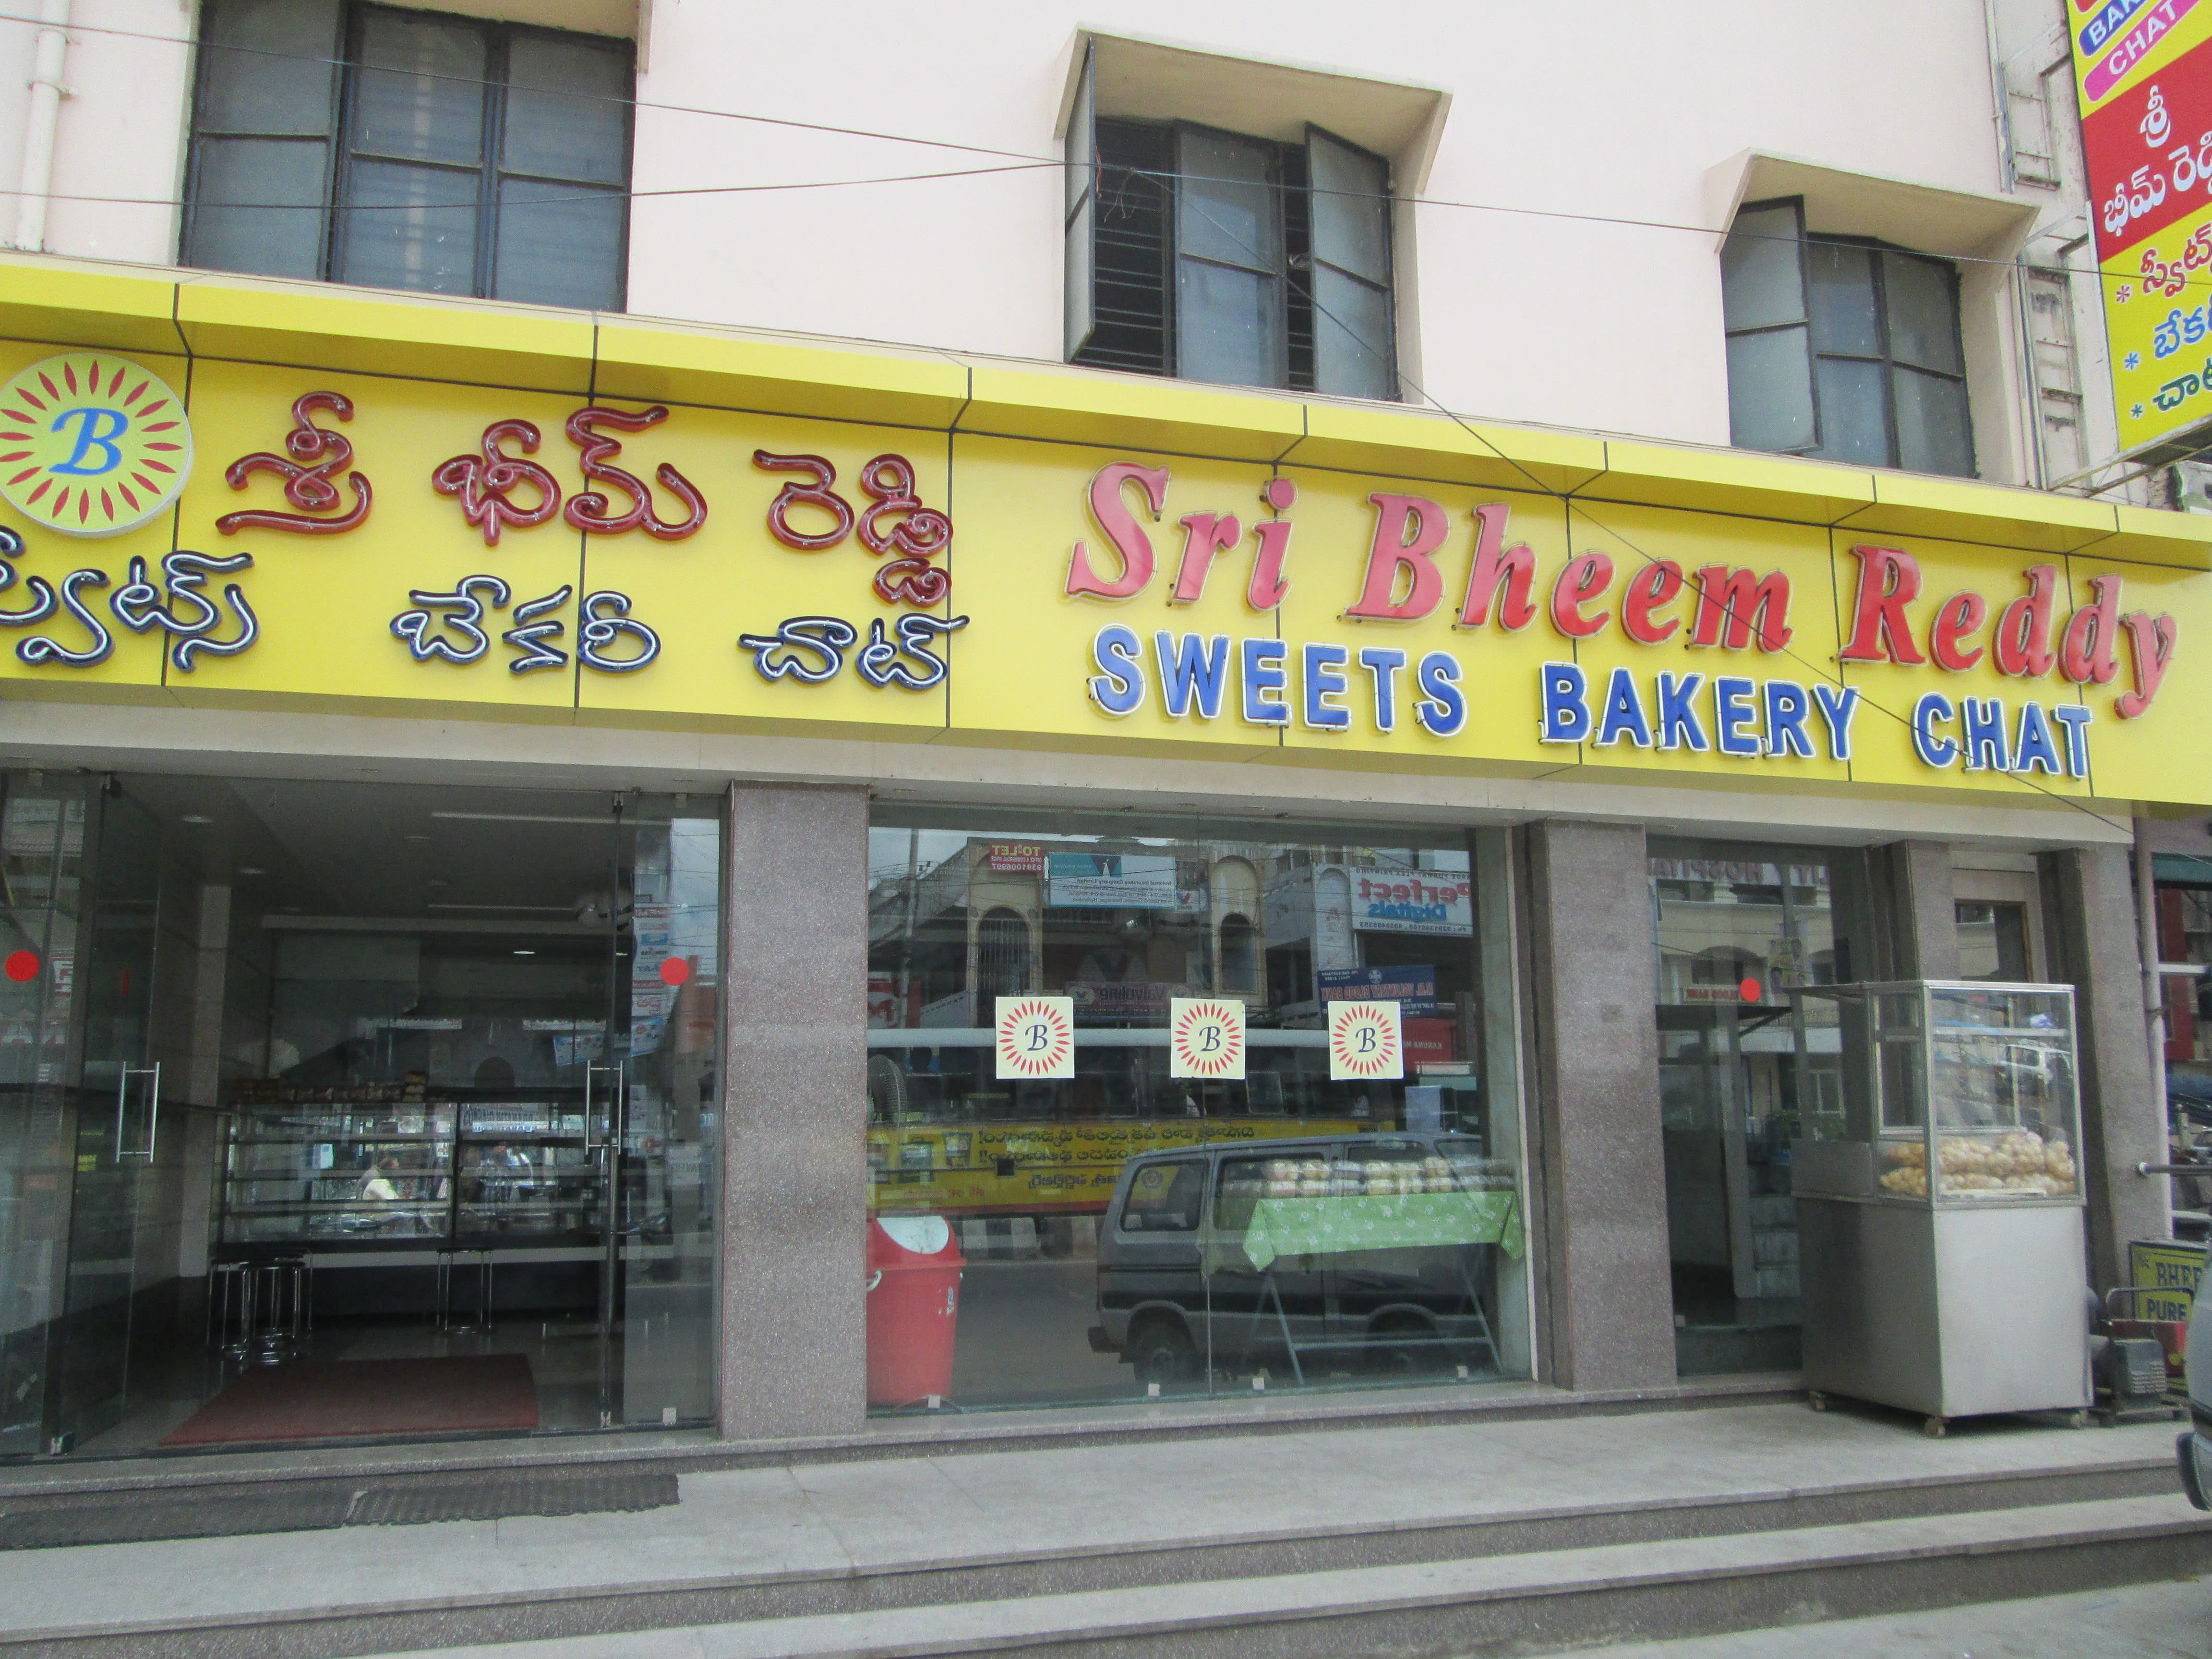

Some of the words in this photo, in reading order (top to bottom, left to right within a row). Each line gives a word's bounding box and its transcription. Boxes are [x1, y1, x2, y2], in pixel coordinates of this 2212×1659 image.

[2109, 0, 2176, 74] CHAT
[2140, 85, 2171, 148] శ్రీ
[48, 408, 129, 476] B
[216, 390, 373, 535] శ్రీ
[752, 449, 953, 608] రెడ్డి
[1064, 461, 1299, 612] Sri
[1343, 492, 1793, 654] Bheem
[1836, 543, 2179, 719] Reddy
[737, 613, 970, 691] చాట్
[1088, 623, 1468, 738] SWEETS
[1538, 661, 1859, 761] BAKERY
[1911, 691, 2093, 779] CHAT
[1025, 1024, 1048, 1051] B
[1199, 1026, 1221, 1052] B
[1355, 1028, 1377, 1053] B
